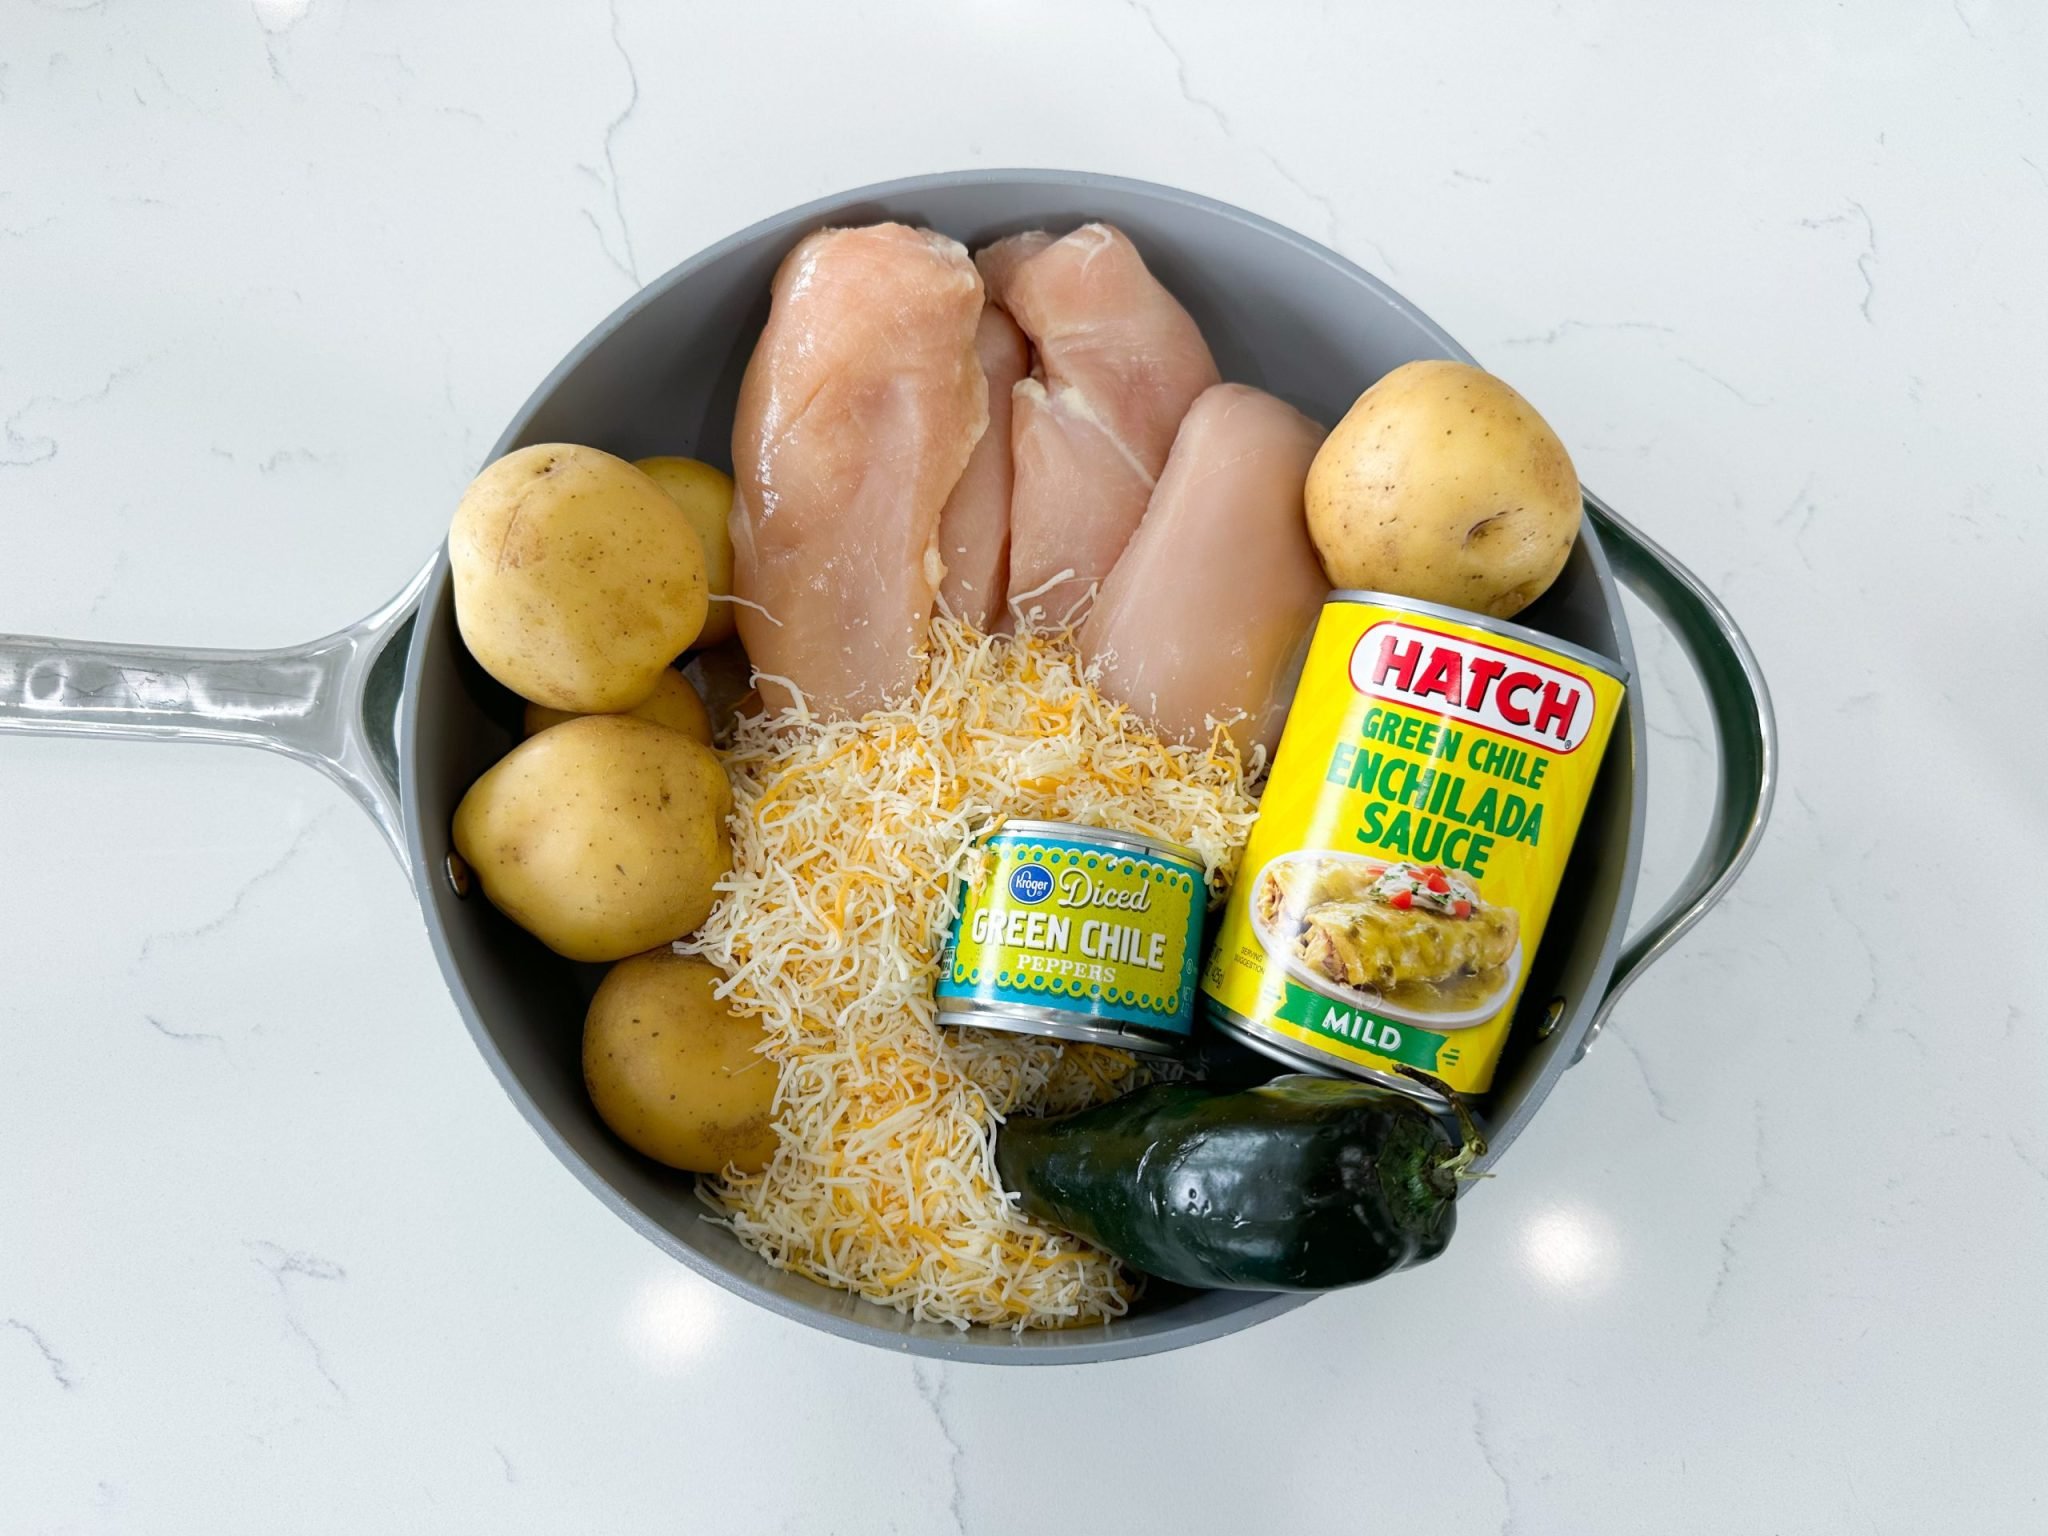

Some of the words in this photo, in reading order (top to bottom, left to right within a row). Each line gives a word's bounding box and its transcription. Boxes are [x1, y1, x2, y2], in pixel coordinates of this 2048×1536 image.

[1371, 635, 1581, 741] HATCH
[1361, 707, 1463, 763] GREEN
[1467, 738, 1549, 791] CHILE
[1326, 741, 1544, 847] ENCHILADA
[1356, 801, 1495, 880] SAUCE
[1015, 870, 1049, 898] Kroger
[1057, 867, 1151, 913] Diced
[971, 907, 1072, 953] GREEN
[1079, 919, 1168, 972] CHILE
[1016, 953, 1117, 984] PEPPERS
[1322, 1006, 1402, 1051] MILD
